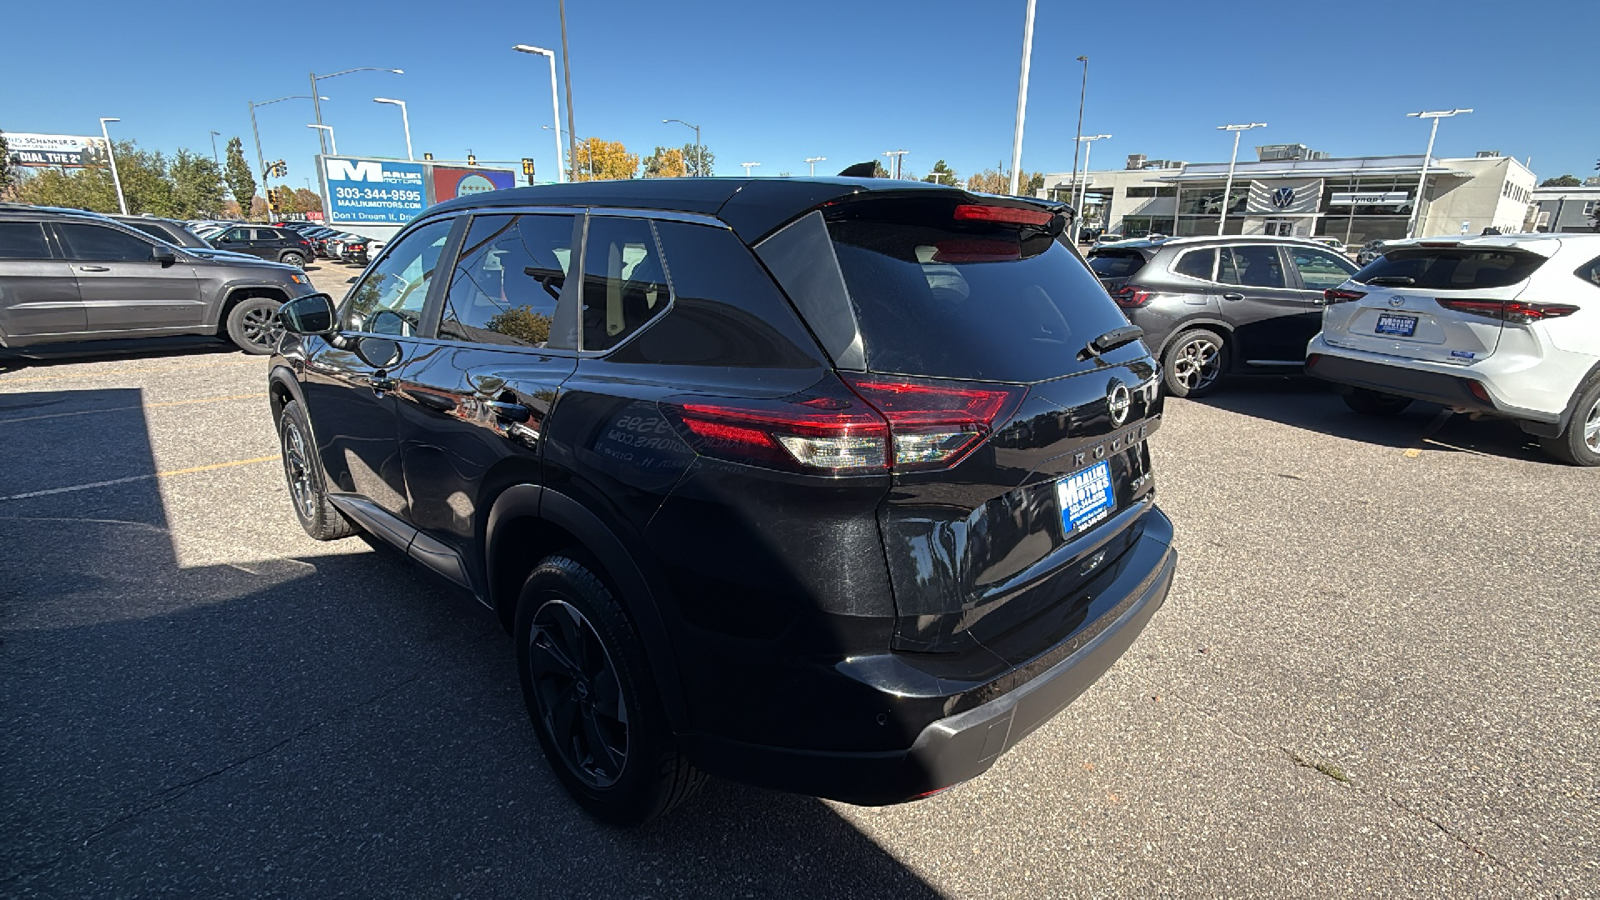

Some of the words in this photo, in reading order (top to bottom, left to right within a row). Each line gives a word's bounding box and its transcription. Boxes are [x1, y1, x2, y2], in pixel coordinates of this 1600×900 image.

[24, 137, 69, 145] SCHANKER
[19, 151, 47, 162] DIAL
[45, 152, 69, 163] THE
[336, 187, 420, 201] 303-344-9595
[337, 199, 422, 209] MAALIKIMOTORS.COM
[333, 211, 356, 219] Don't
[358, 212, 387, 220] Dream
[1074, 425, 1148, 467] ROGUE
